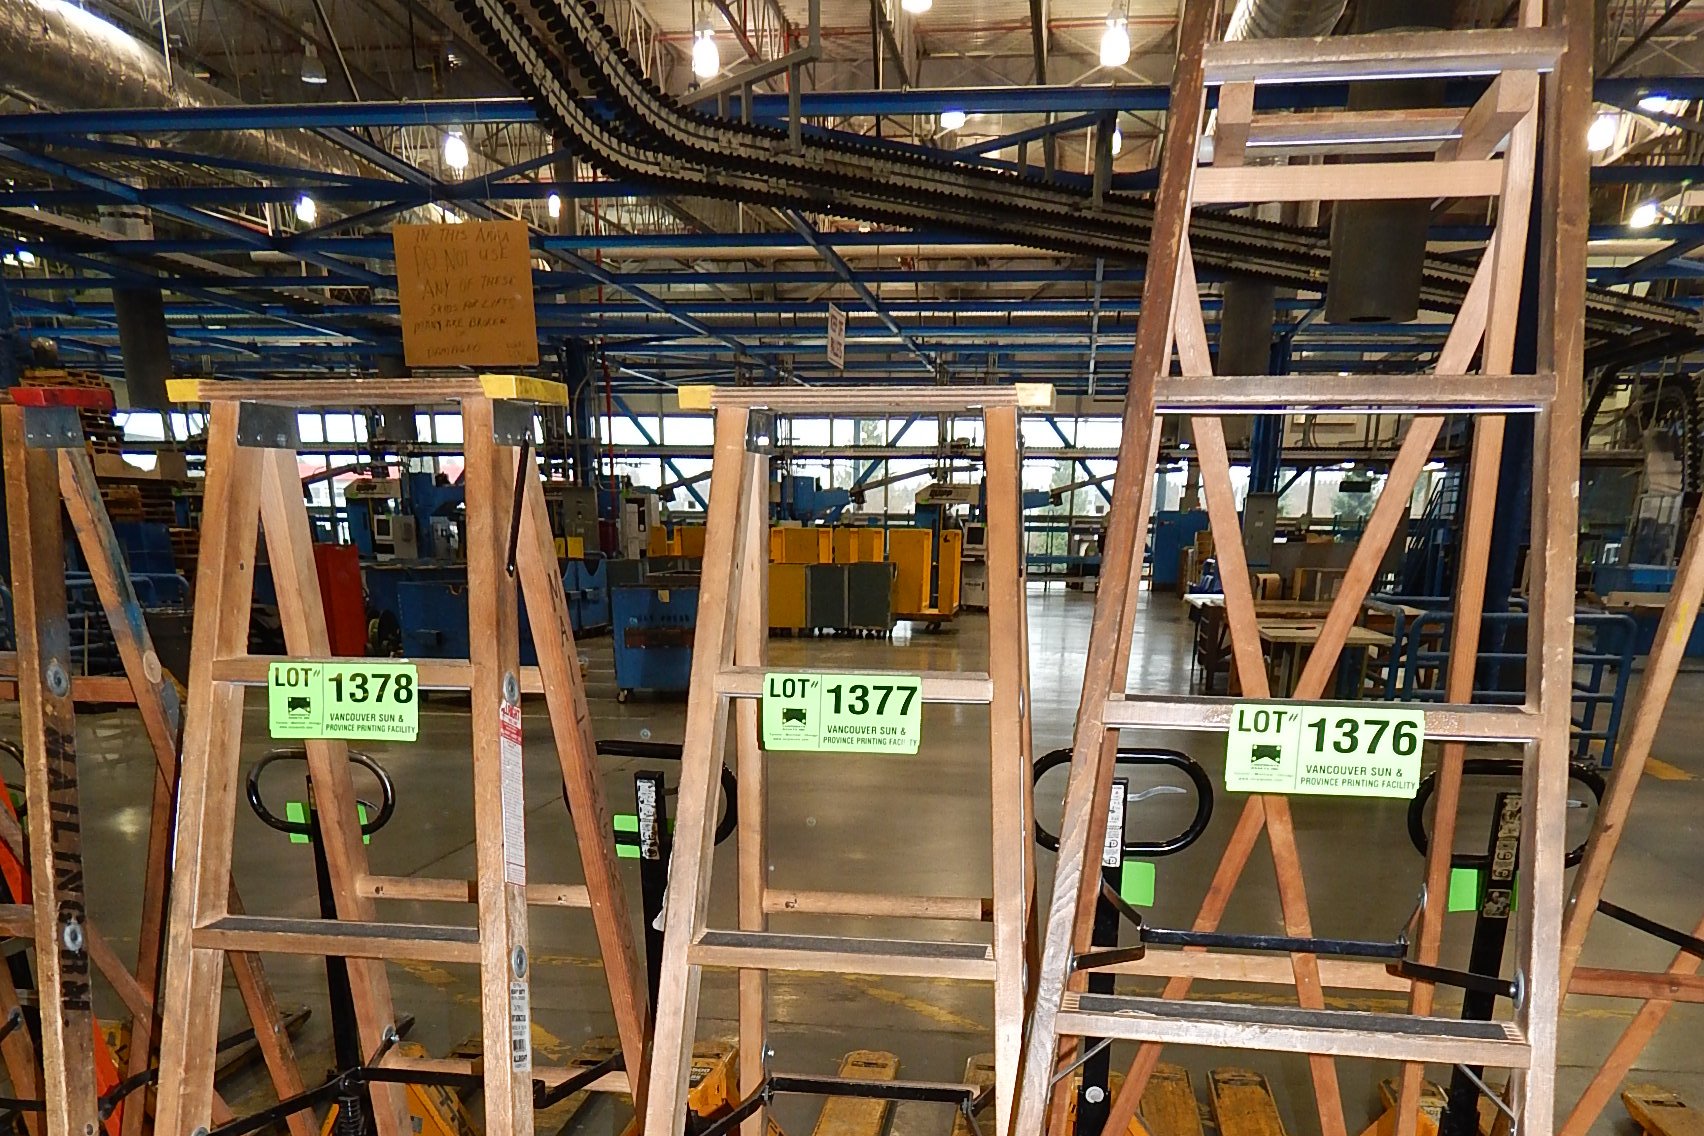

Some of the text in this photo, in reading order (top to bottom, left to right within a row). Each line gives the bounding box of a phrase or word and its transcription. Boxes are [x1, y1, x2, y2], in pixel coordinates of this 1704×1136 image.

[416, 228, 431, 243] IN
[440, 228, 468, 242] THIS
[444, 248, 469, 272] NOT
[479, 245, 508, 261] USE
[422, 278, 450, 300] ANY
[481, 274, 515, 289] THESE
[469, 317, 507, 329] BROKEN
[328, 672, 413, 704] 1378
[827, 684, 918, 716] 1377
[330, 713, 404, 723] VANCOUVER SUN &
[325, 724, 355, 732] PROVINCE
[357, 724, 385, 733] PRINTING
[388, 725, 416, 734] FACILITY
[827, 725, 906, 736] VANCOUVER SUN &
[823, 736, 854, 744] PROVINCE
[857, 737, 887, 745] PRINTING
[889, 738, 918, 746] FACITY
[1308, 717, 1419, 756] 1376
[1305, 764, 1403, 777] VANCOUVER SUN &
[1300, 777, 1339, 786] PROVINCE
[1341, 778, 1379, 788] PRINTING
[1382, 780, 1416, 790] FACILITY
